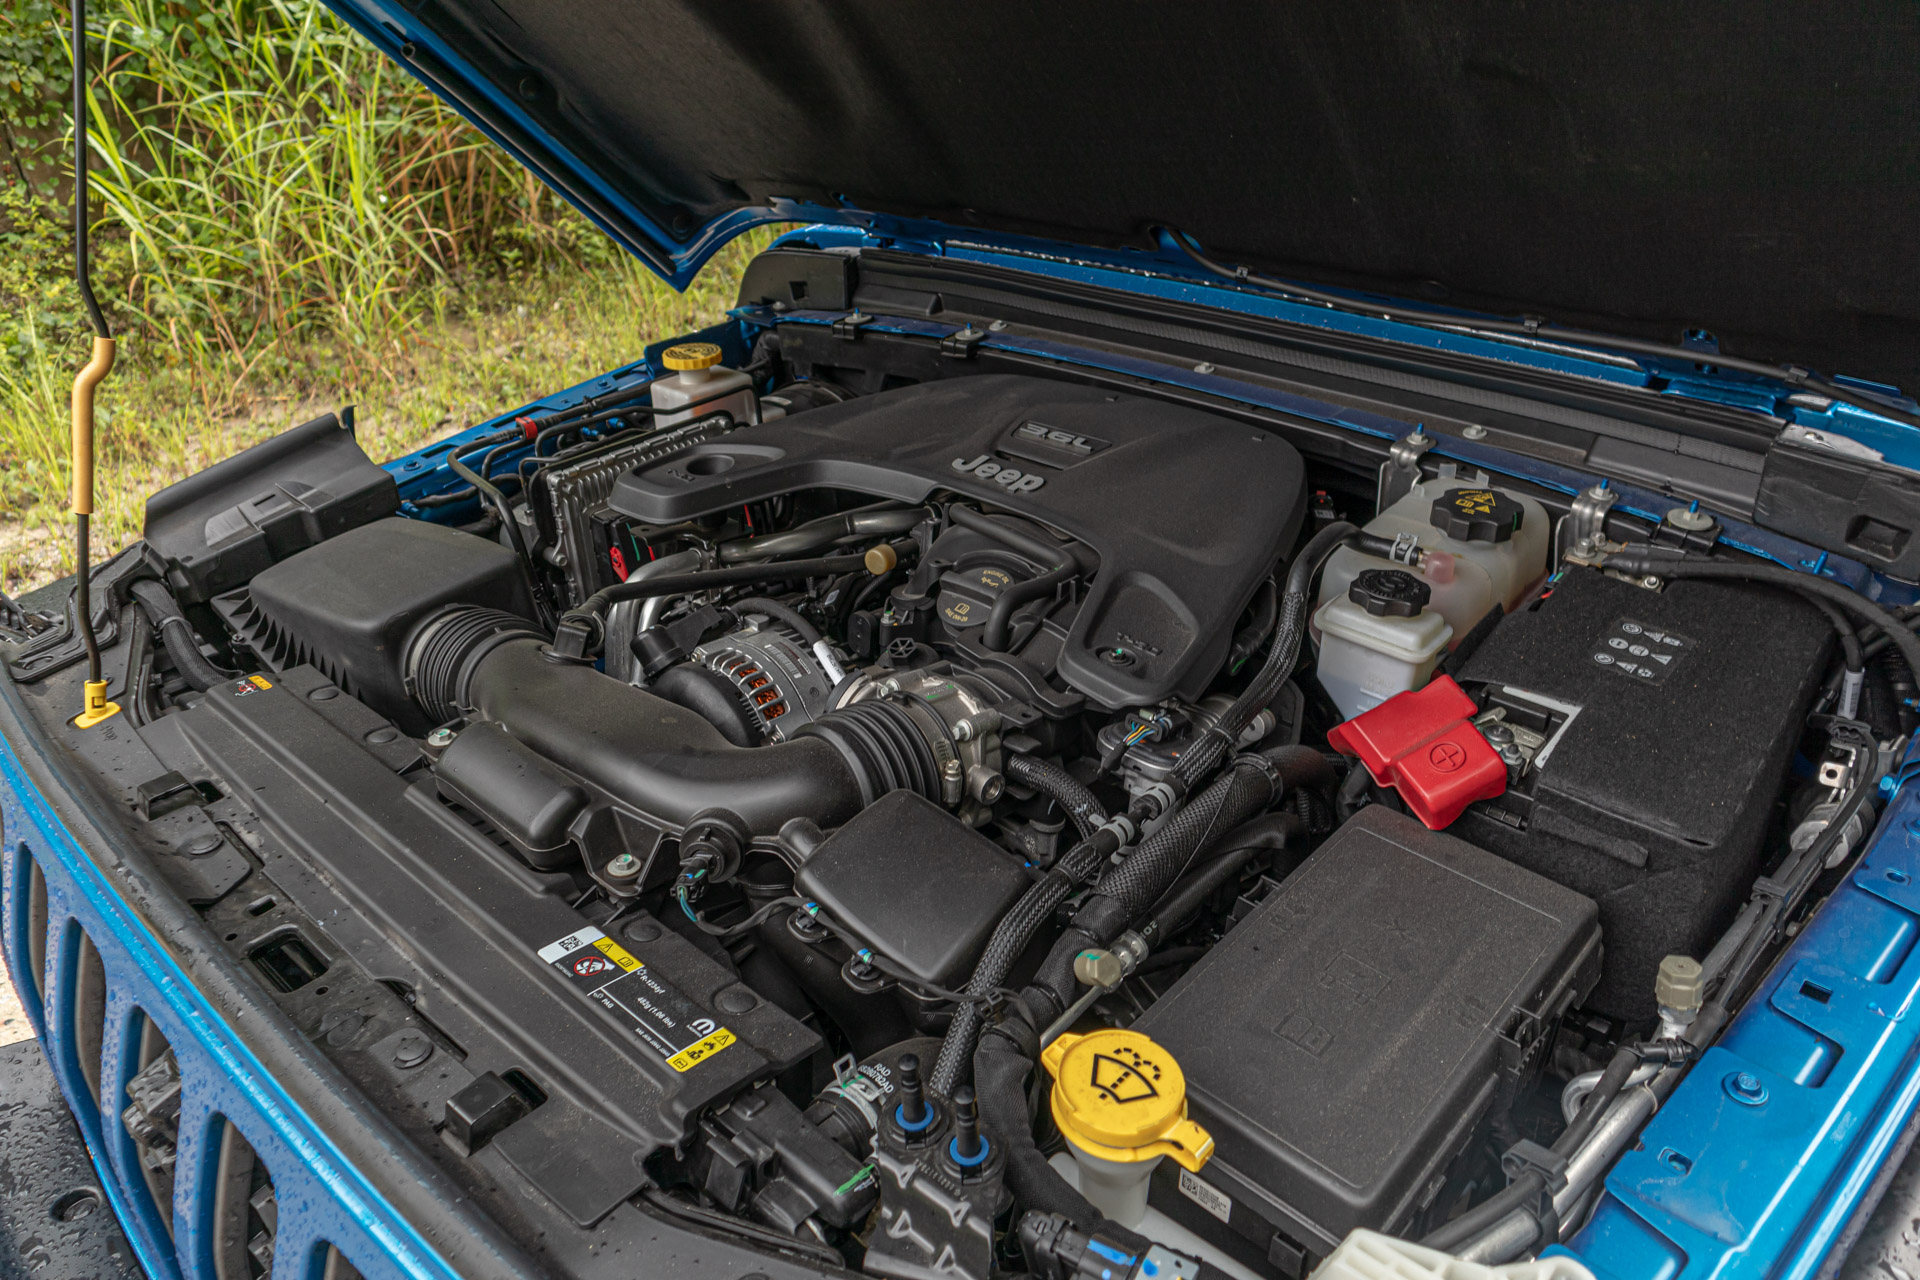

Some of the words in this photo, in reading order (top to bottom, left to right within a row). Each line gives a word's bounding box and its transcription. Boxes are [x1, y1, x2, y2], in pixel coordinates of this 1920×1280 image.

[1019, 423, 1092, 453] 3.6L
[952, 455, 1045, 493] Jeep
[640, 975, 665, 994] R-1234yf
[602, 998, 614, 1009] PAG
[873, 1063, 891, 1077] RAD
